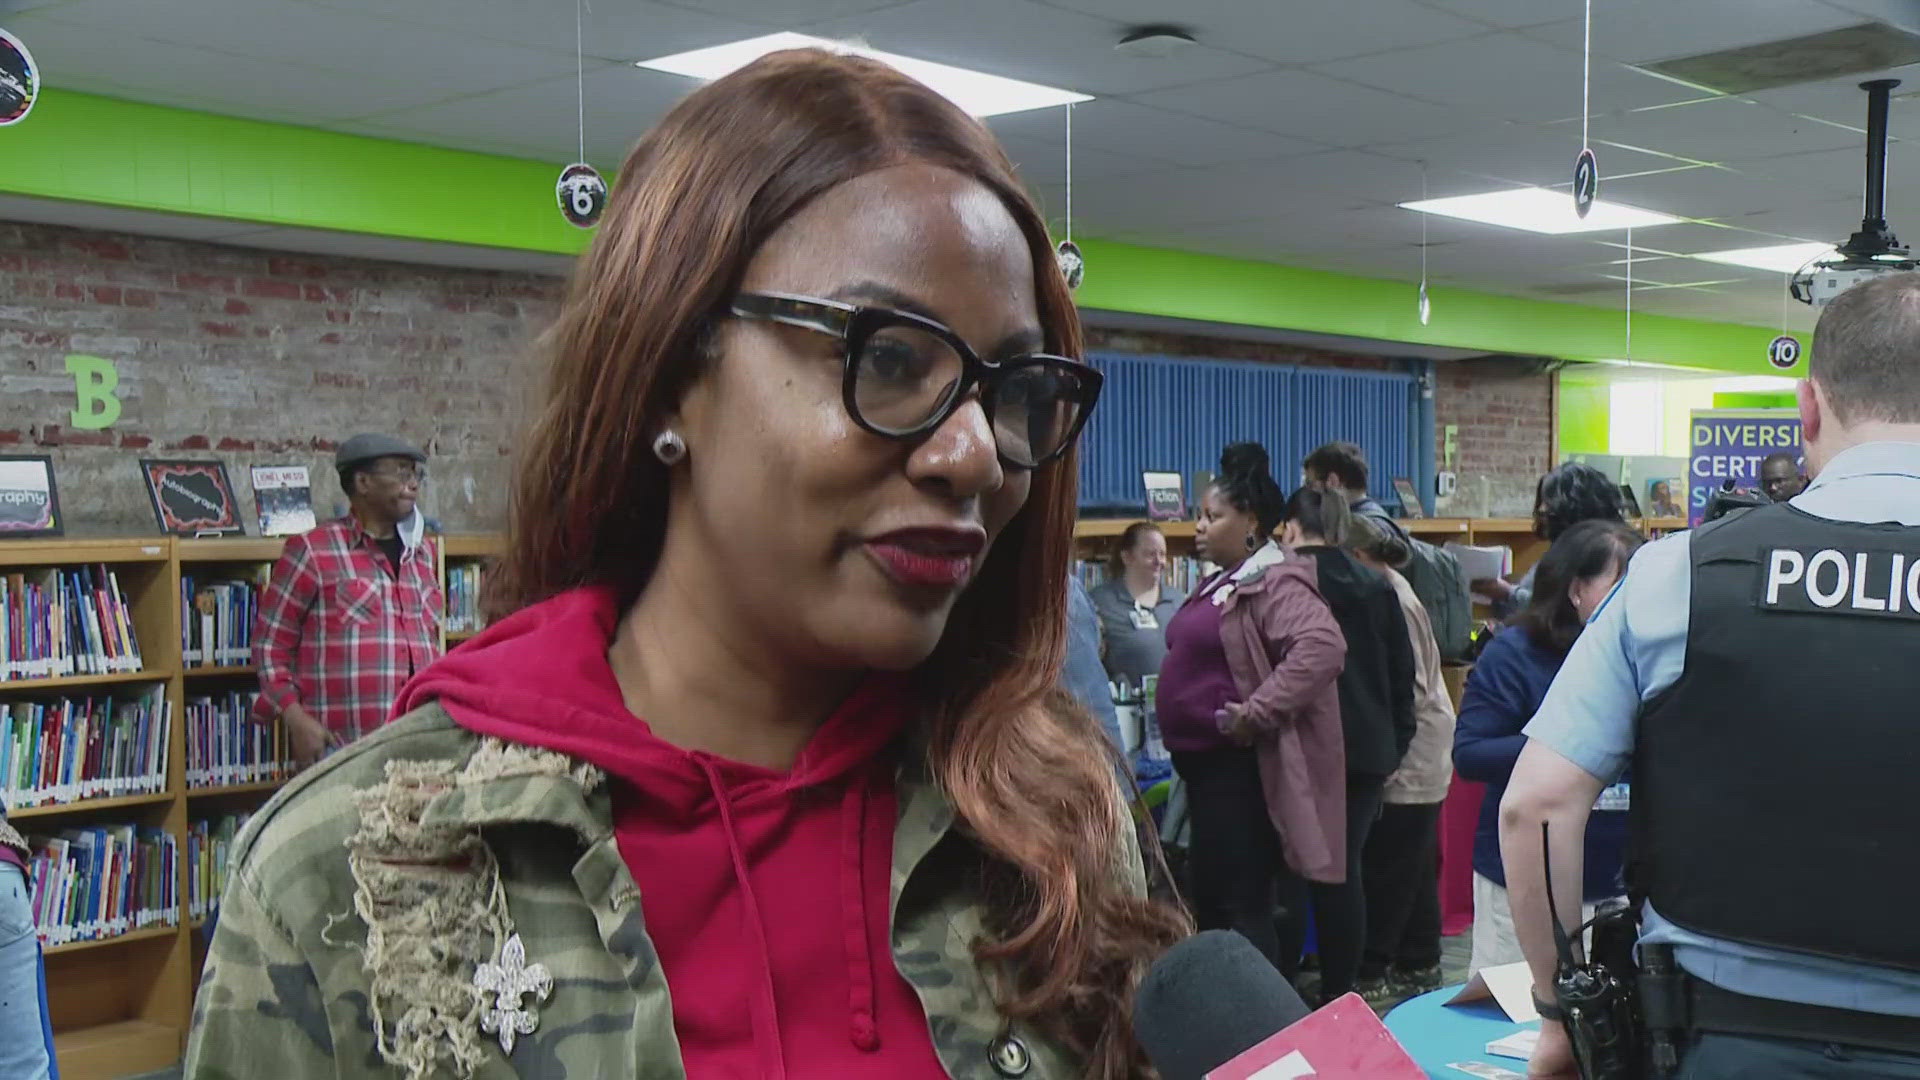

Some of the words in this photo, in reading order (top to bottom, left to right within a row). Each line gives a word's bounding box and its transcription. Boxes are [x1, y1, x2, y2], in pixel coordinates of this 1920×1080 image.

[1579, 163, 1590, 204] 2
[572, 181, 594, 216] 6
[1774, 341, 1796, 362] 10
[64, 354, 122, 430] B
[1693, 424, 1800, 447] DIVERSI
[1149, 489, 1180, 503] Fiction
